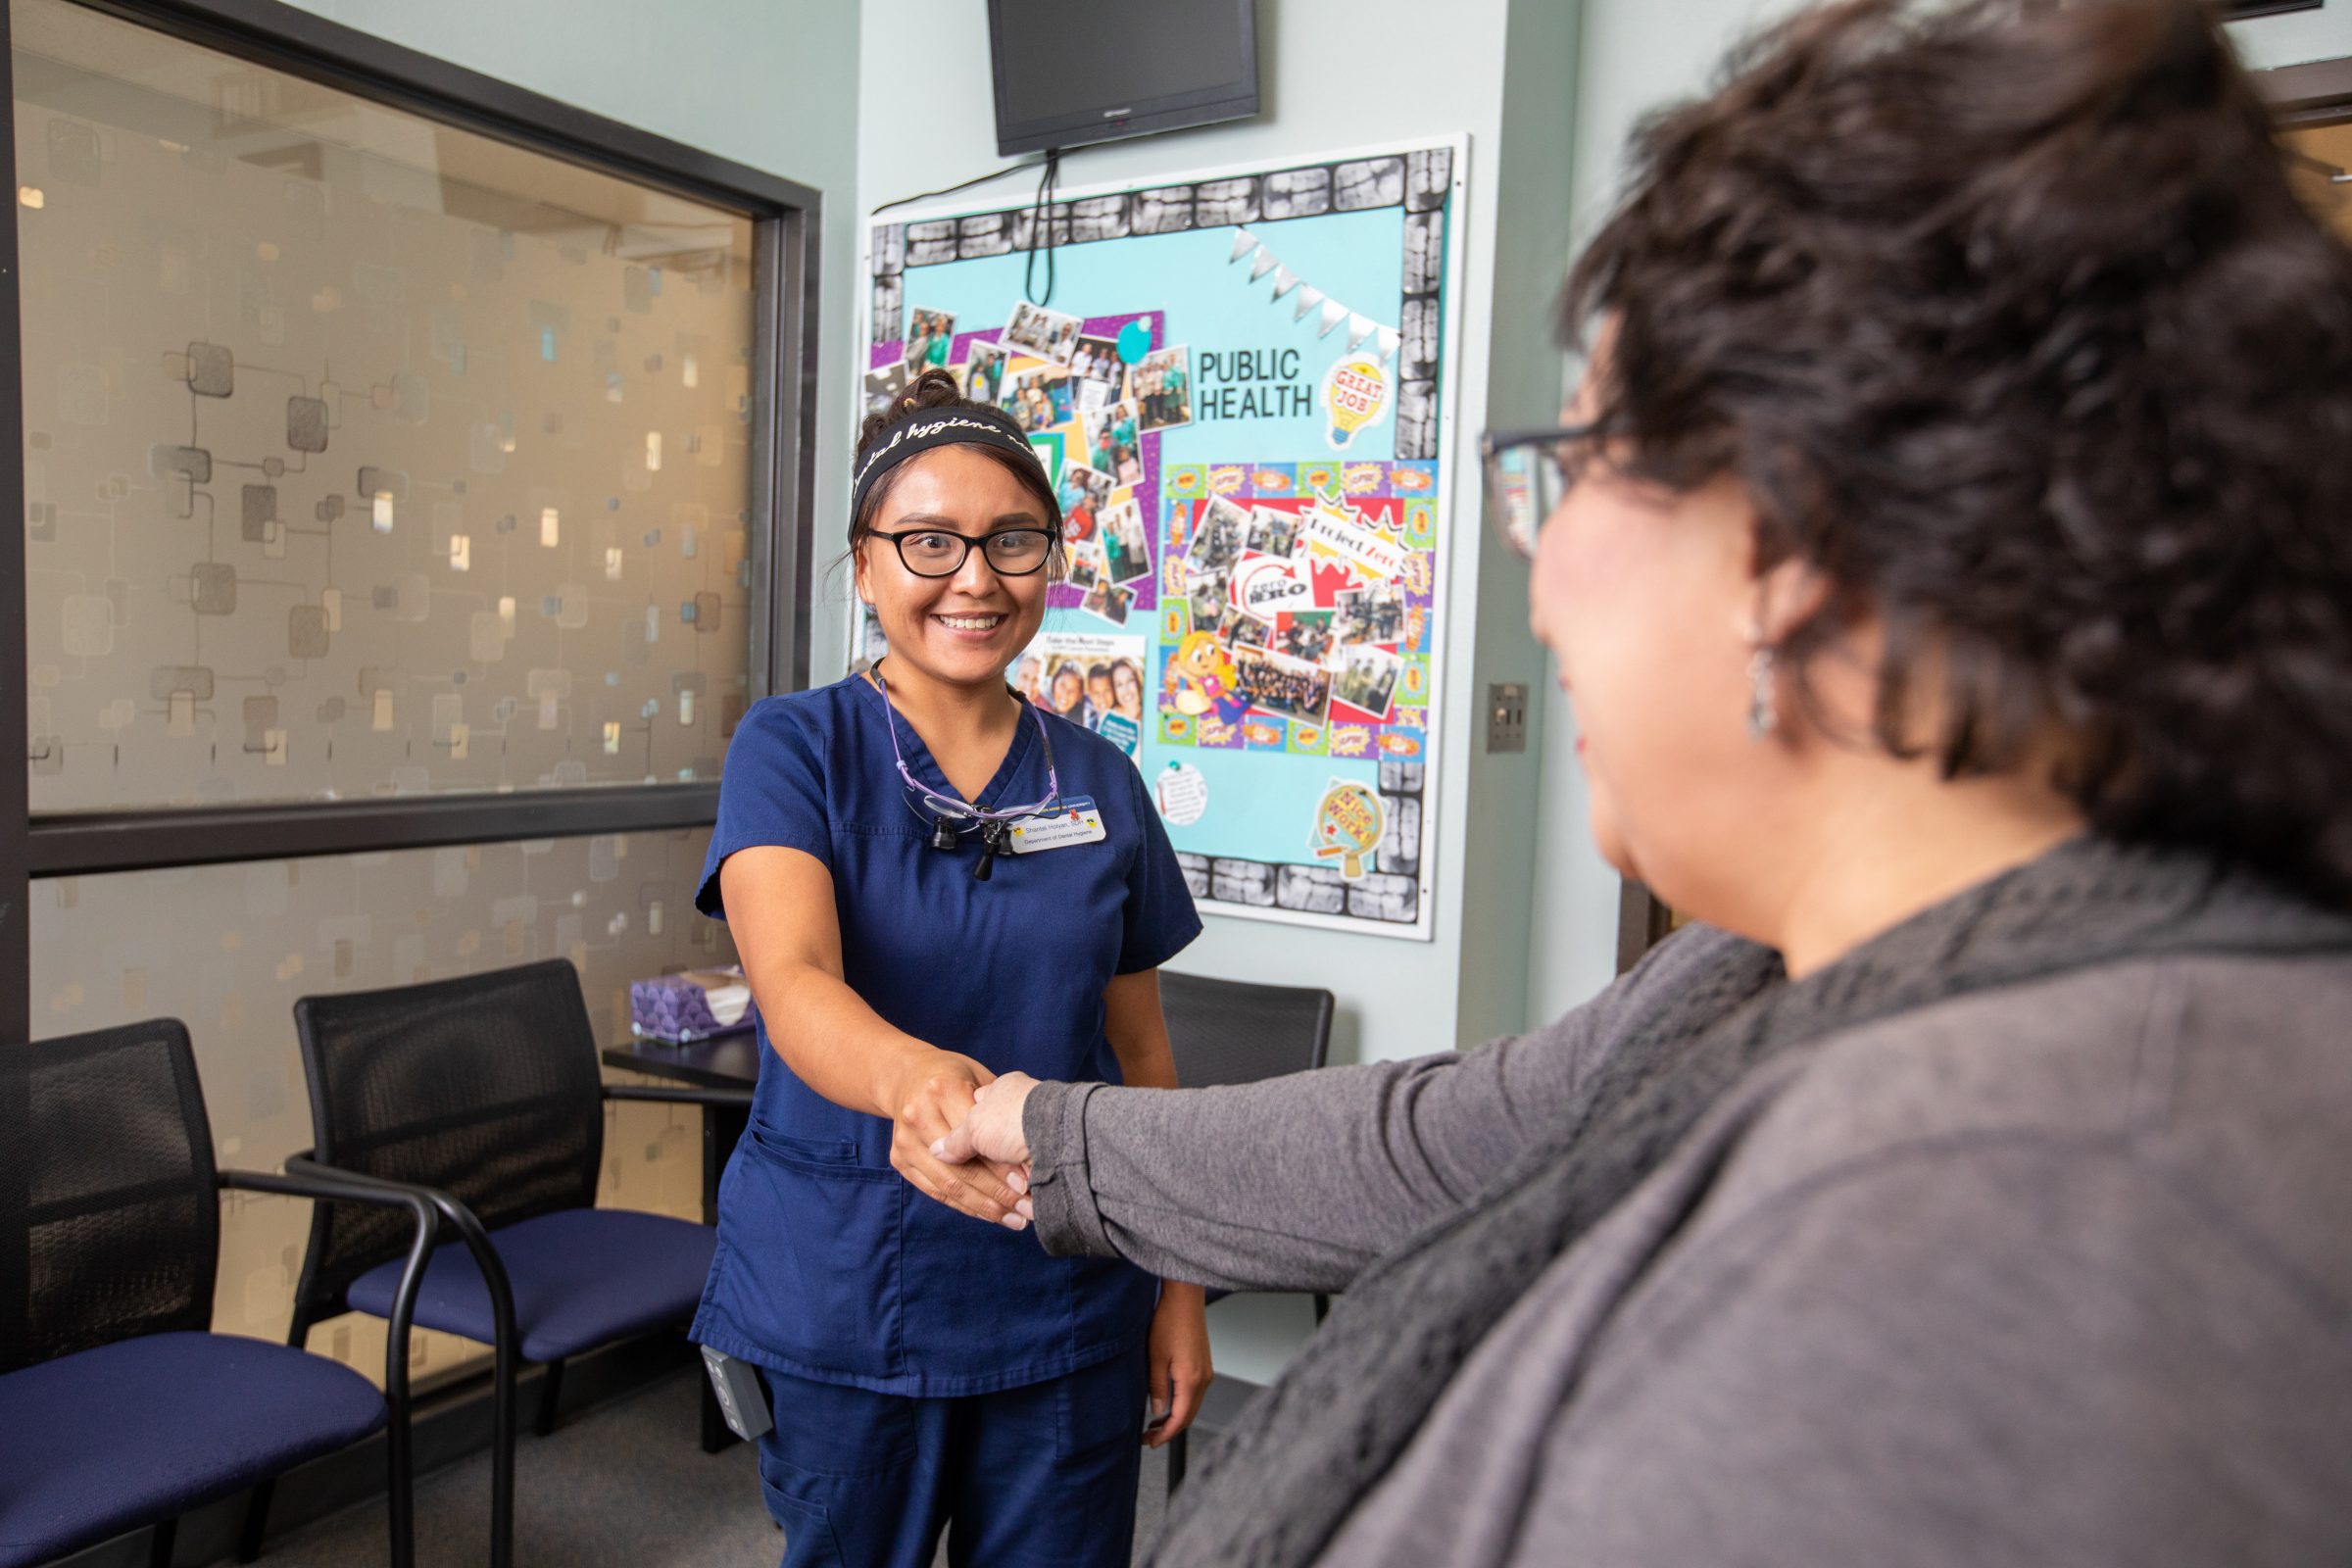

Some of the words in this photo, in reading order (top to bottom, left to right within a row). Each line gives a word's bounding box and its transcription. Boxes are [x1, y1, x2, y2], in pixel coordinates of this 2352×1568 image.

[1200, 348, 1300, 384] PUBLIC
[1200, 384, 1312, 421] HEALTH
[1335, 369, 1383, 400] GREAT
[1336, 389, 1369, 413] JOB
[906, 416, 1002, 440] hygiene
[1309, 517, 1363, 552] Project
[1365, 546, 1397, 568] Zero
[1328, 799, 1373, 843] Work!
[1339, 789, 1373, 825] Nice
[1024, 836, 1052, 845] Department
[1074, 829, 1093, 838] Hygiene
